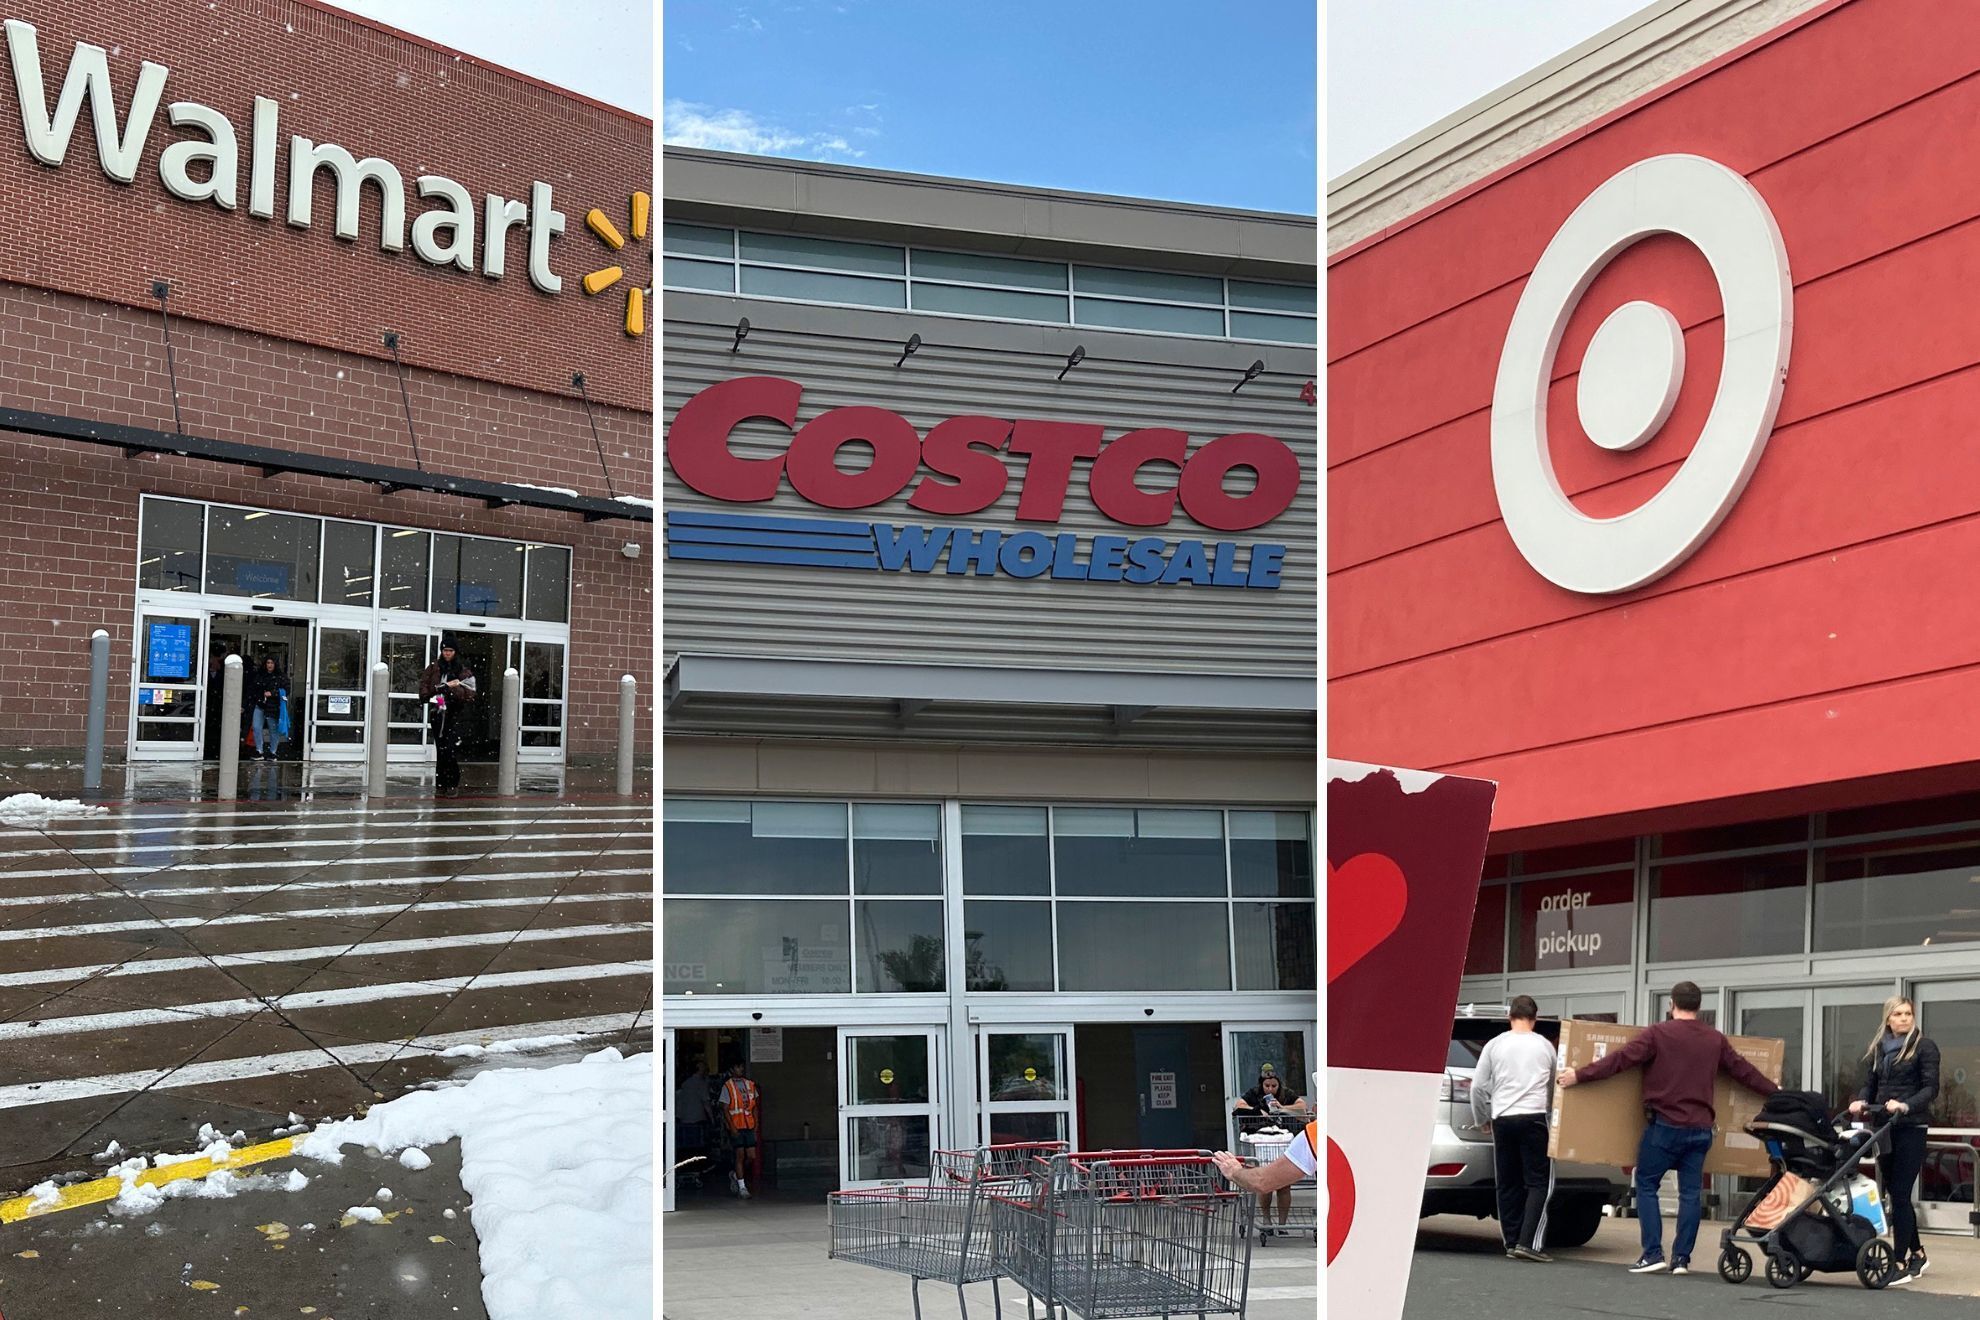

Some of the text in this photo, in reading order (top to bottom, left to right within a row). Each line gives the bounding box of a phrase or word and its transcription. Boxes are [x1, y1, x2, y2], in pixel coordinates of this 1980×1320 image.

[3, 18, 565, 294] Walmart
[667, 376, 1301, 531] COSTCO
[873, 523, 1287, 589] WHOLESALE
[1540, 888, 1591, 912] order
[1538, 929, 1602, 960] pickup
[1586, 1033, 1627, 1043] SAMSUNG
